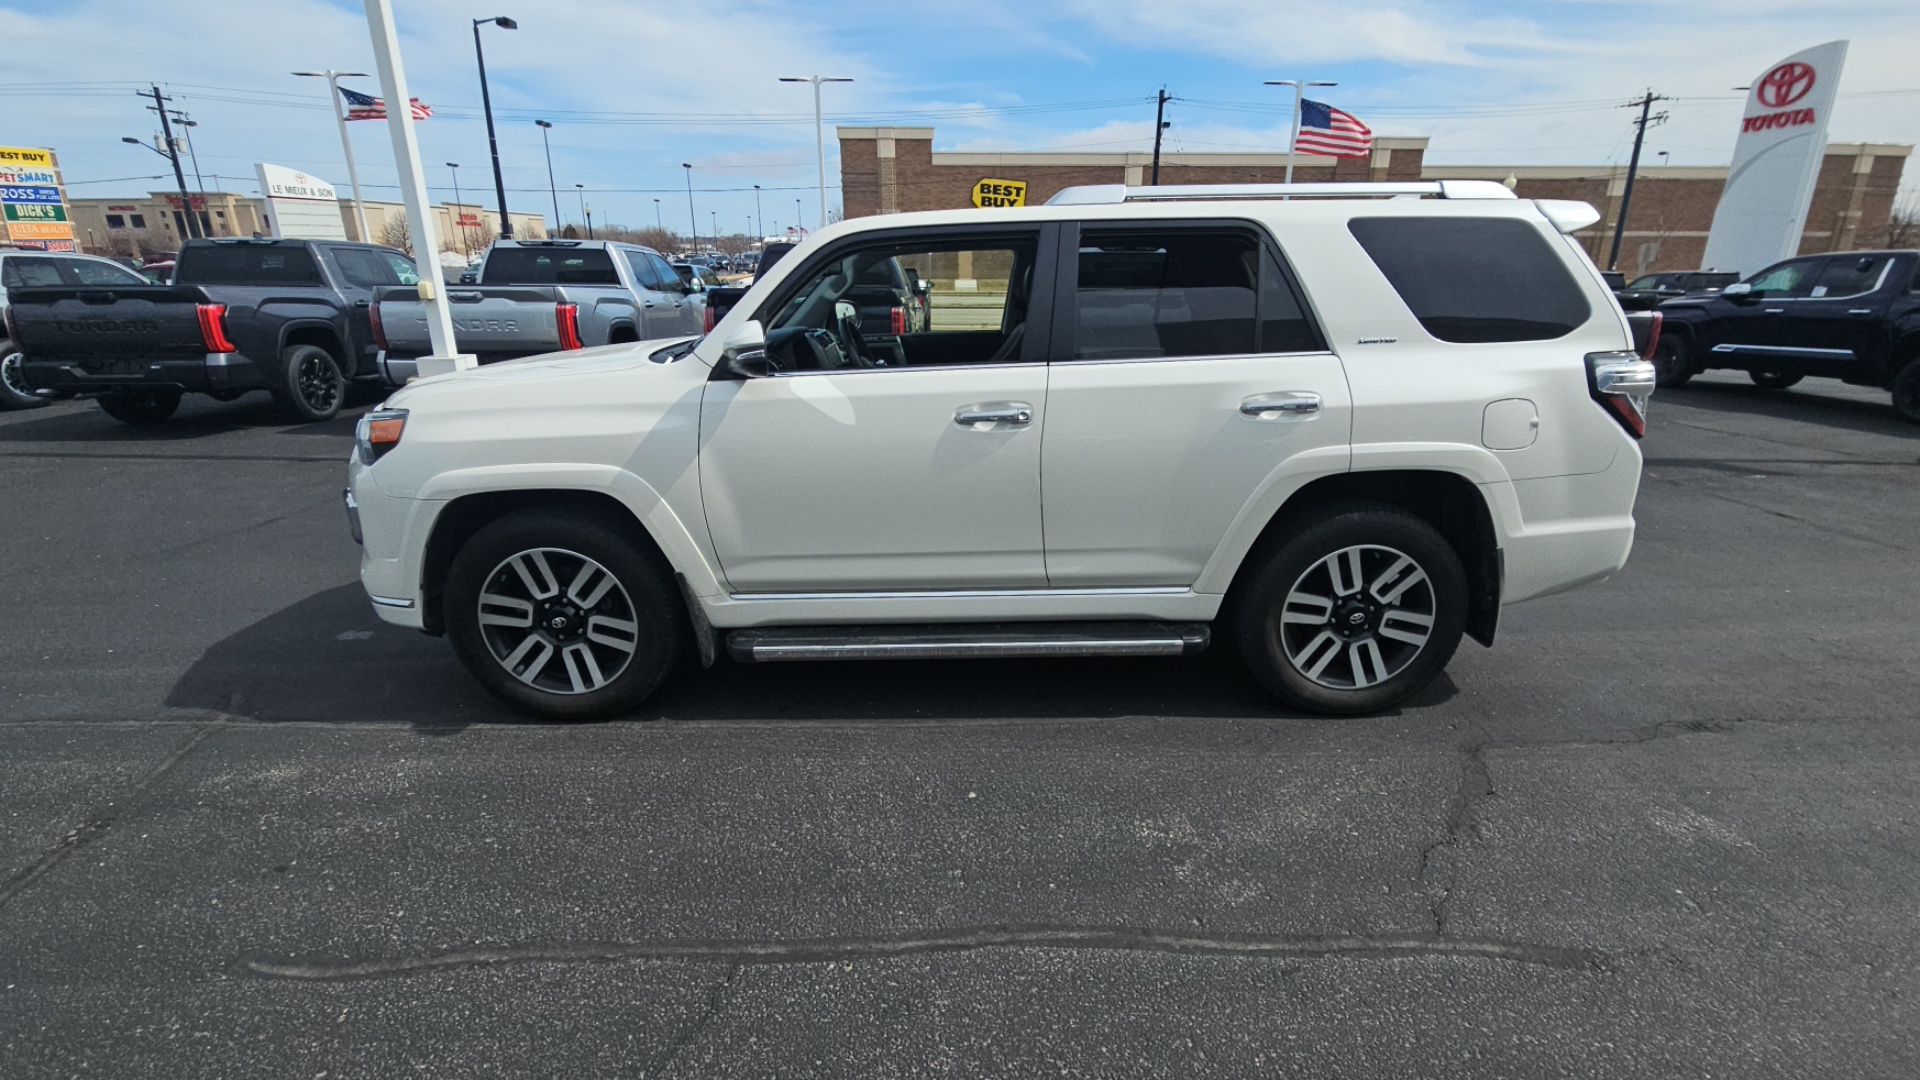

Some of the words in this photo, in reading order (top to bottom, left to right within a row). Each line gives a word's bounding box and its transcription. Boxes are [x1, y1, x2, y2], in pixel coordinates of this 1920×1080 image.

[1743, 108, 1815, 133] TOYOTA
[0, 151, 19, 160] EST
[21, 153, 45, 162] BUY
[0, 188, 35, 199] ROSS
[272, 184, 283, 194] LE
[285, 185, 308, 196] MIEUX
[310, 187, 316, 196] &
[317, 188, 333, 197] SON
[980, 184, 1024, 198] BEST
[981, 196, 1018, 208] BUY
[15, 204, 55, 217] DICK'S
[11, 223, 39, 235] ULTA
[52, 320, 159, 334] TUNDRA
[416, 318, 520, 332] TNDRA
